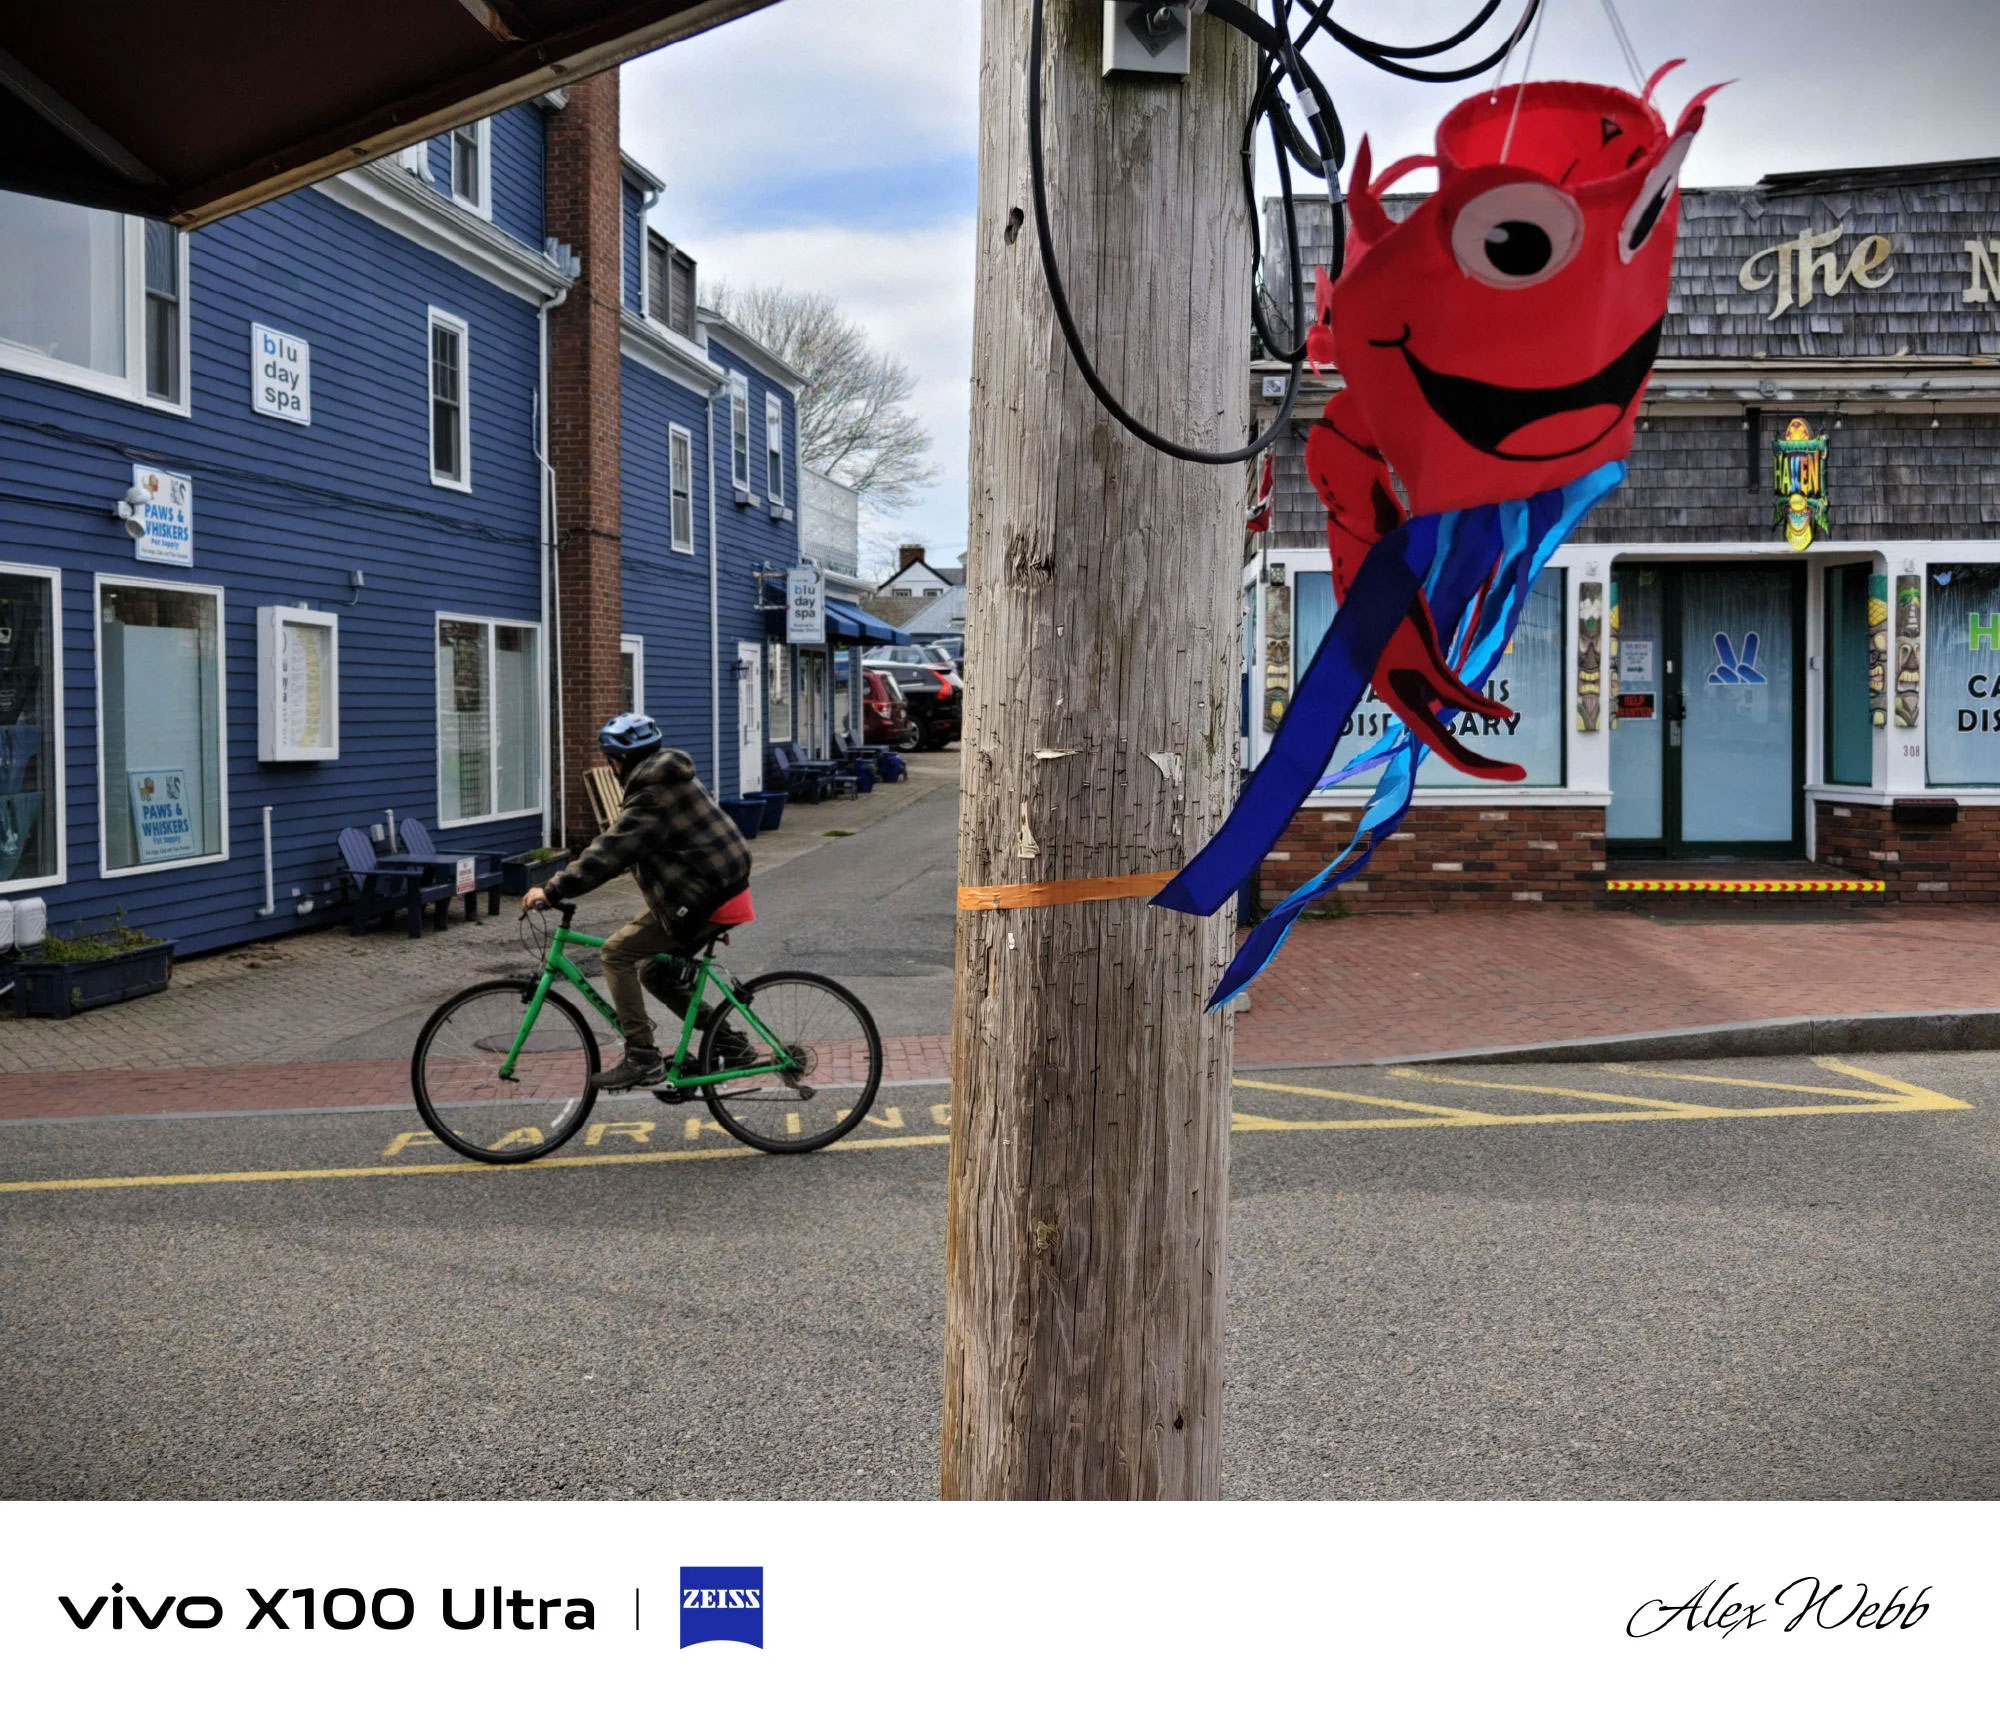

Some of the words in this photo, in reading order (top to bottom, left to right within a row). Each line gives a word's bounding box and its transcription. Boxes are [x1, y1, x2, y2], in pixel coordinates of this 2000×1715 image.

[1739, 223, 1895, 321] The
[263, 333, 298, 362] blu
[264, 361, 300, 391] day
[264, 386, 302, 412] spa
[144, 503, 174, 522] PAWS
[177, 509, 185, 523] &
[793, 584, 816, 595] blu
[794, 596, 816, 609] day
[794, 609, 816, 621] spa
[1340, 712, 1522, 737] DISARY
[1903, 745, 1921, 758] 308
[142, 803, 173, 820] PAWS
[175, 802, 183, 817] &
[142, 818, 190, 837] WHISKERS
